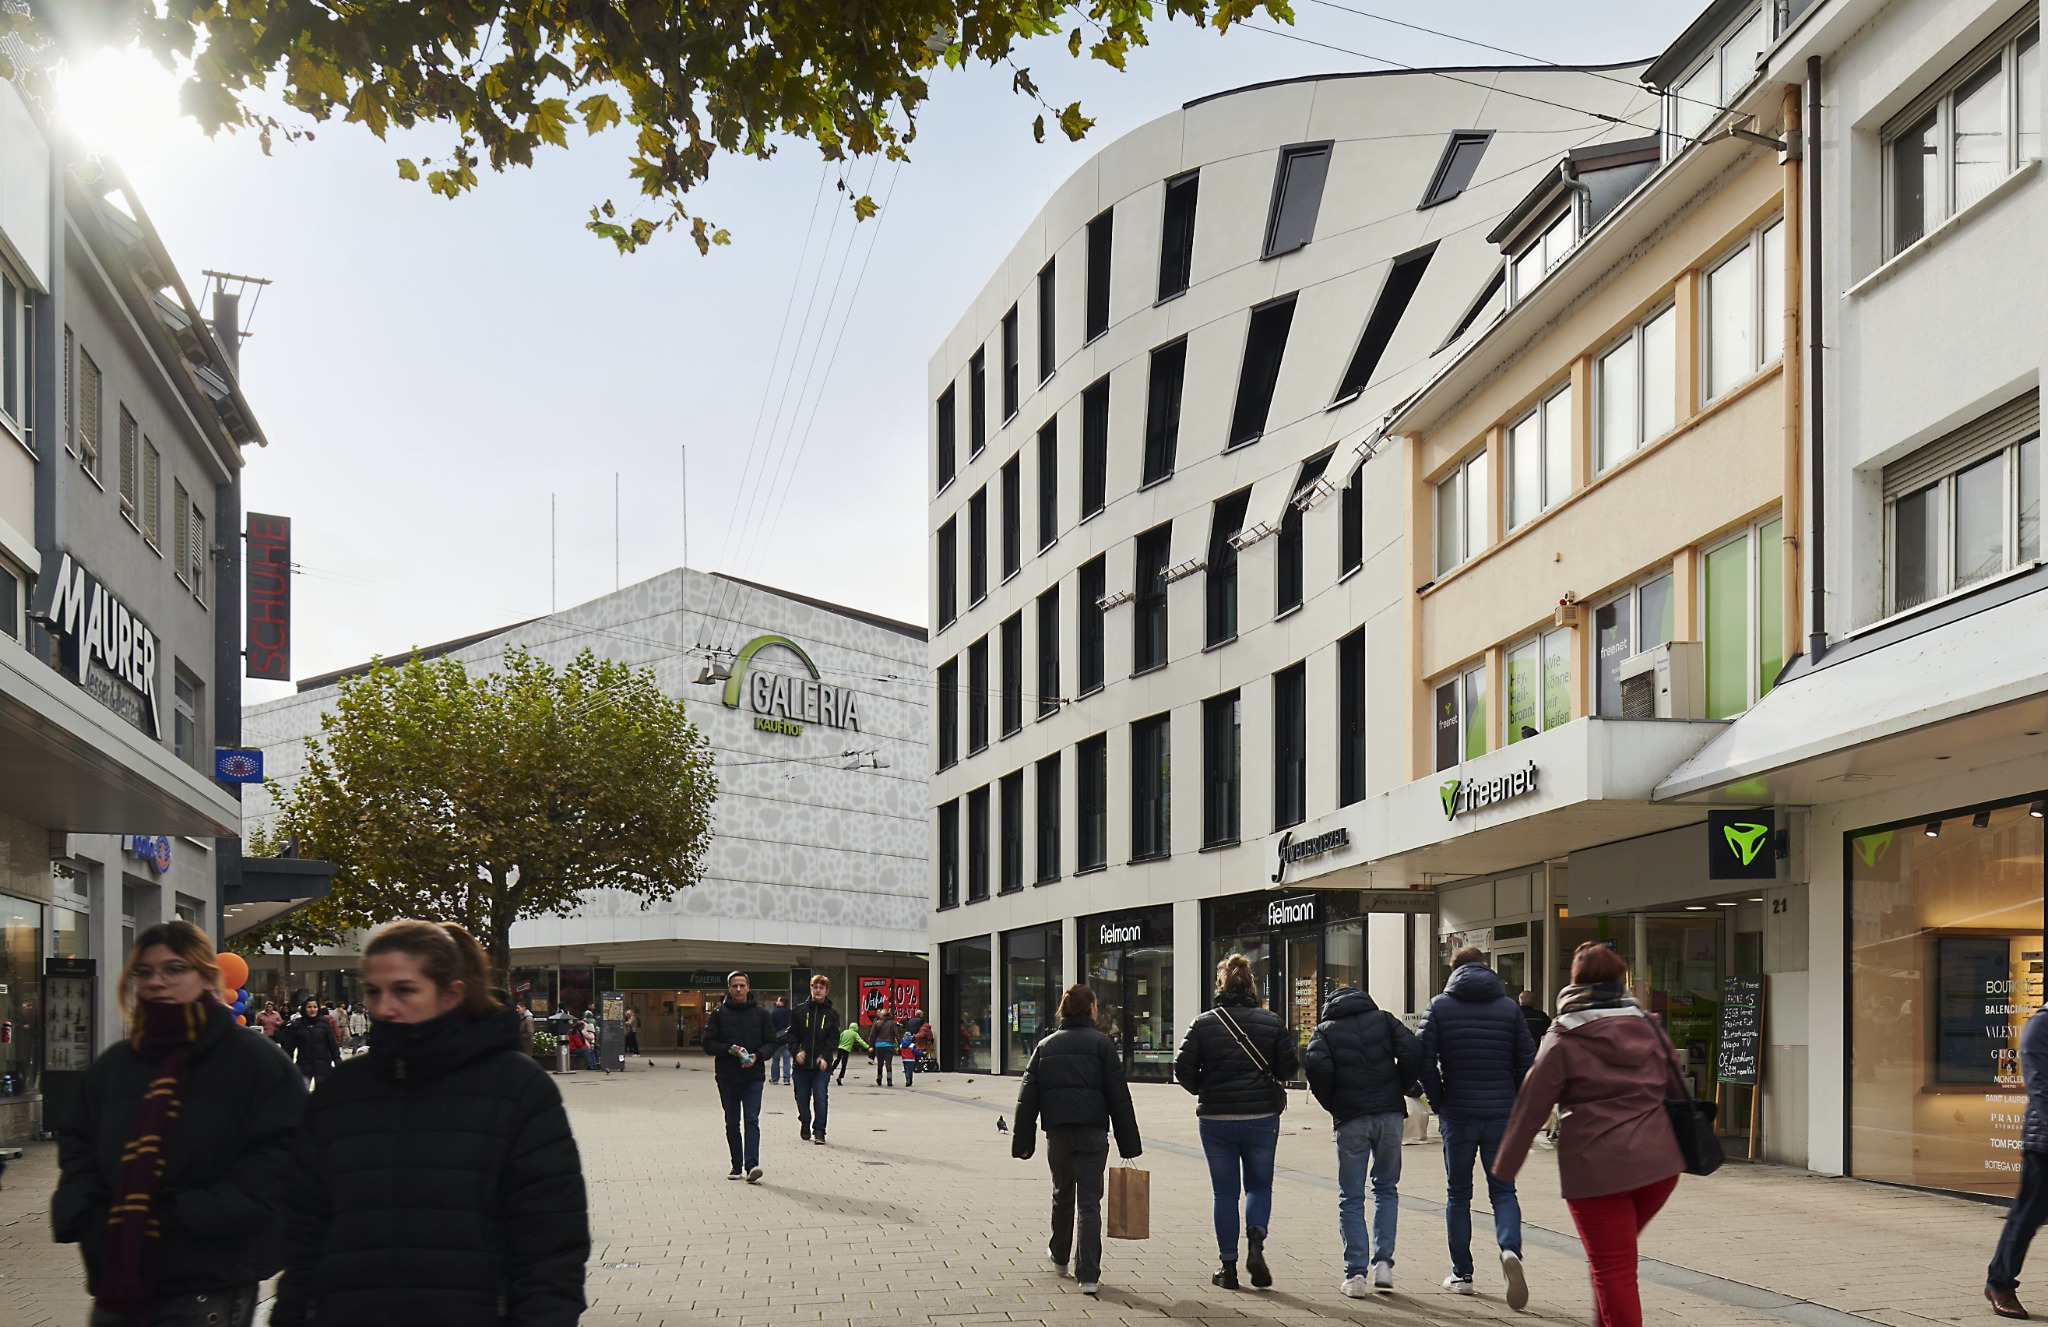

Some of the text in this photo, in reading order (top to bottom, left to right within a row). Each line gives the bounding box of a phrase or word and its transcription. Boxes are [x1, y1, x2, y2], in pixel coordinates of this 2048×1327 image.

[251, 517, 287, 676] SCHUHE
[49, 552, 162, 741] MAURER
[1601, 638, 1628, 659] freenet
[1511, 672, 1527, 687] Hey,
[1546, 672, 1571, 689] könne
[752, 671, 861, 732] GALERIA
[1511, 687, 1528, 706] Heil-
[1546, 695, 1558, 710] wir
[1439, 714, 1458, 731] freenet
[1511, 704, 1535, 725] bronn!
[1464, 760, 1537, 811] freenet
[1268, 900, 1313, 926] fielmann
[1772, 898, 1787, 914] 21
[1100, 923, 1141, 945] fielmann
[695, 975, 721, 983] GALERIA
[1986, 980, 2034, 994] BOUTIQUE
[1745, 993, 1755, 1006] 15
[1985, 1094, 2030, 1105] SAINT LAUREN
[1990, 1138, 2025, 1150] TOM FOR
